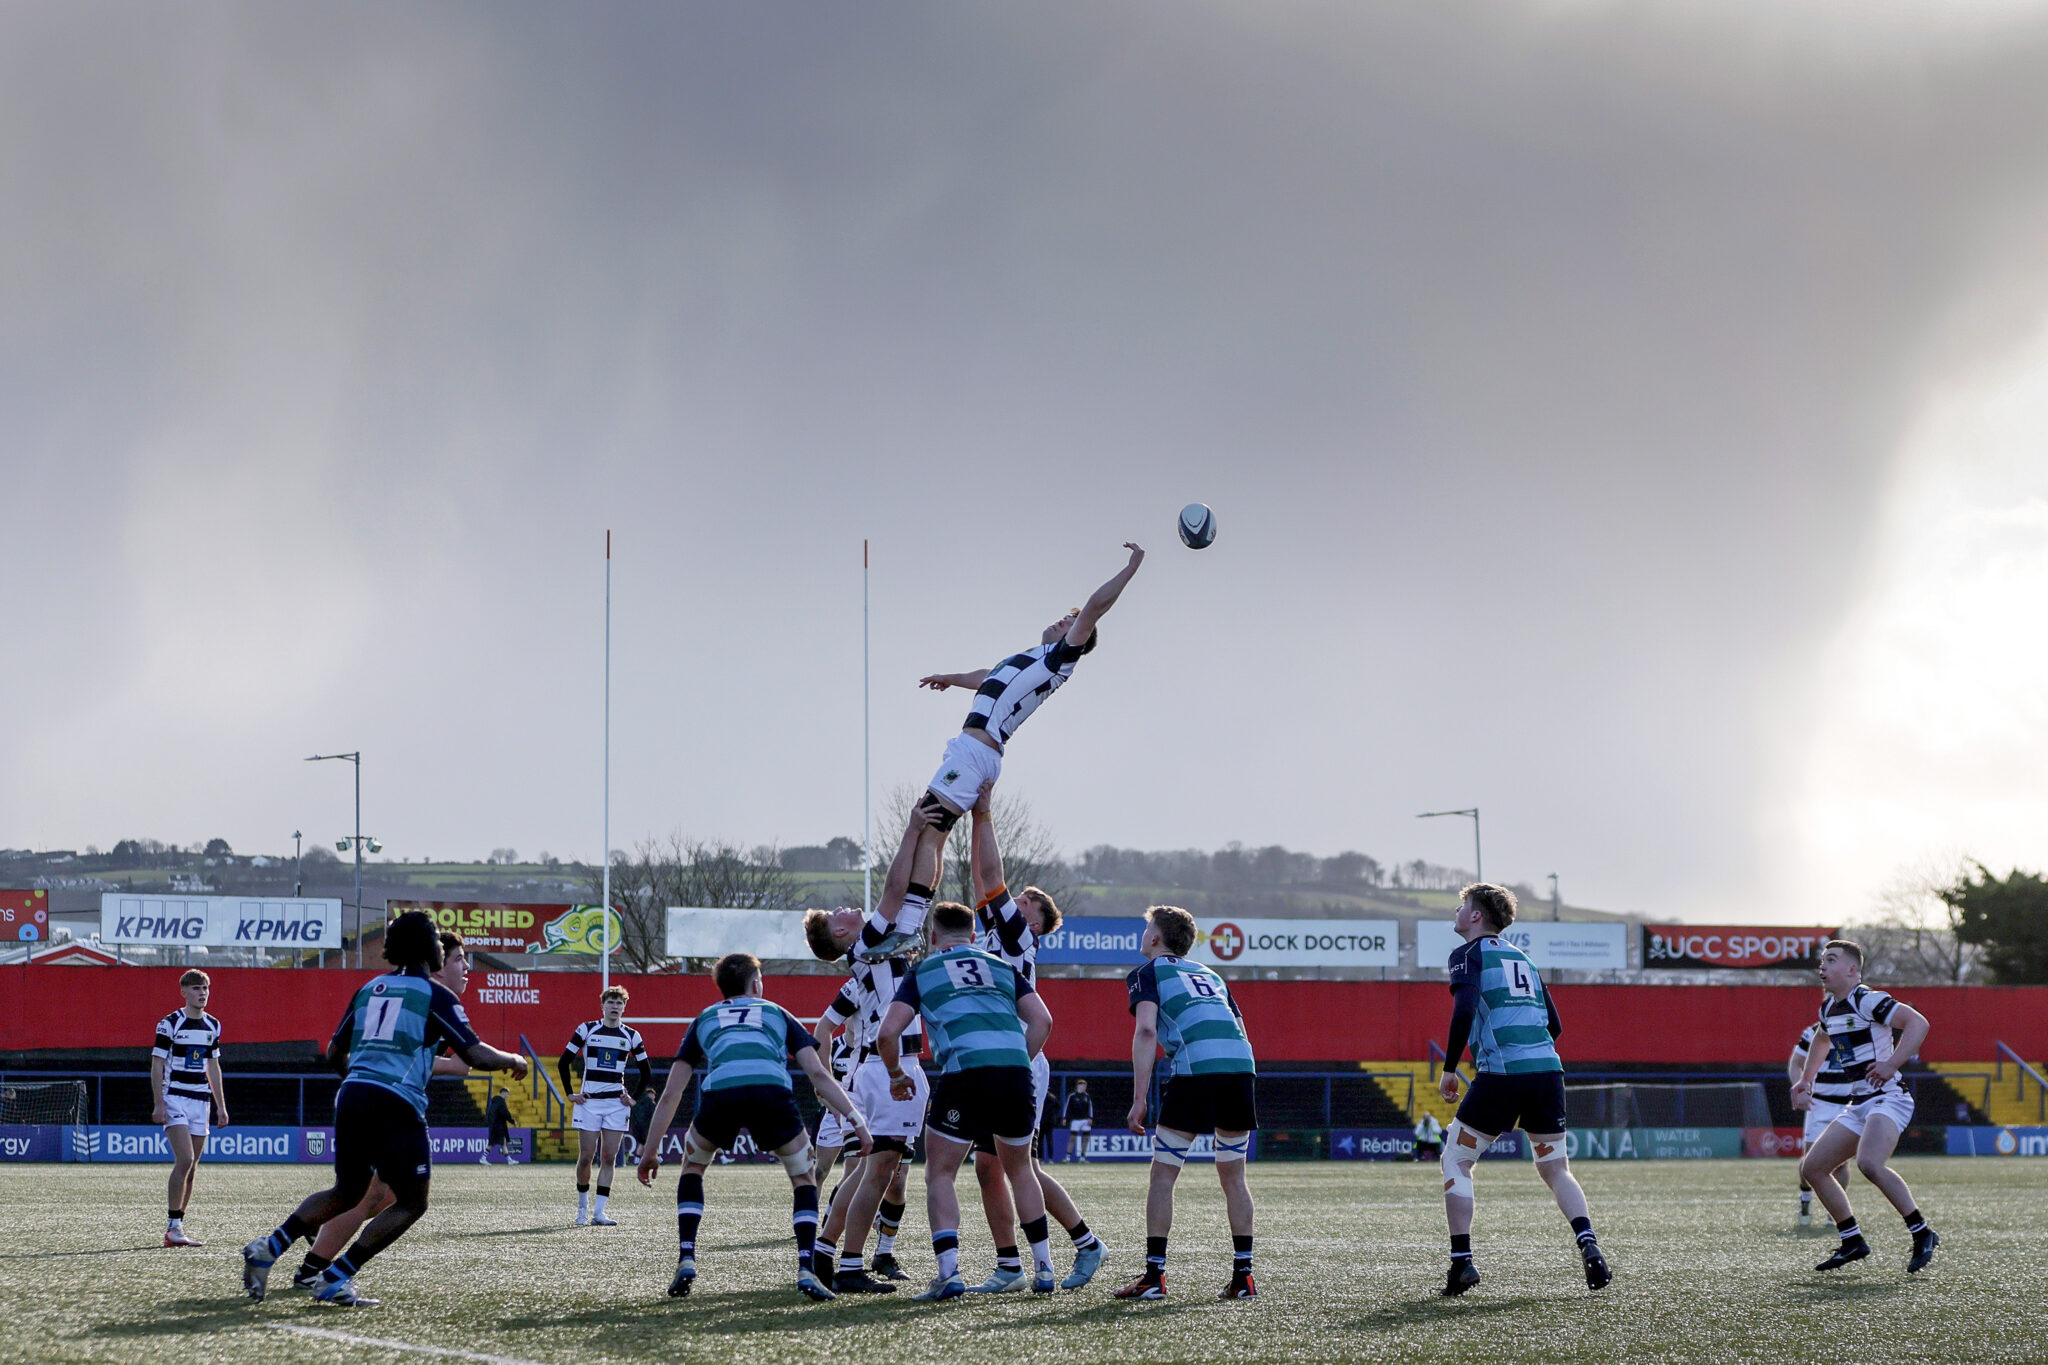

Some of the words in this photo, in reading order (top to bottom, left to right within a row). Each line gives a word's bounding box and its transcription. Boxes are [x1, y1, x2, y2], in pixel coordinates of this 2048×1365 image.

[115, 917, 204, 939] KPMG
[235, 919, 324, 942] KPMG
[464, 928, 490, 937] GRILL
[464, 937, 502, 947] SPORTS
[504, 938, 525, 947] BAR
[1044, 931, 1066, 949] of
[1069, 931, 1138, 950] Ireland
[1249, 935, 1299, 950] LOCK
[1305, 935, 1386, 951] DOCTOR
[1666, 936, 1722, 959] UCC
[486, 973, 529, 988] SOUTH
[955, 959, 984, 986] 3
[1513, 962, 1531, 994] 4
[1187, 973, 1216, 997] 6
[477, 989, 541, 1004] TERRACE
[374, 1000, 390, 1037] 1
[728, 1008, 751, 1023] 7
[107, 1132, 169, 1155] Bank
[203, 1133, 290, 1155] Ireland
[1655, 1129, 1701, 1142] WATER
[442, 1138, 465, 1153] APP
[1361, 1138, 1413, 1154] Réalta
